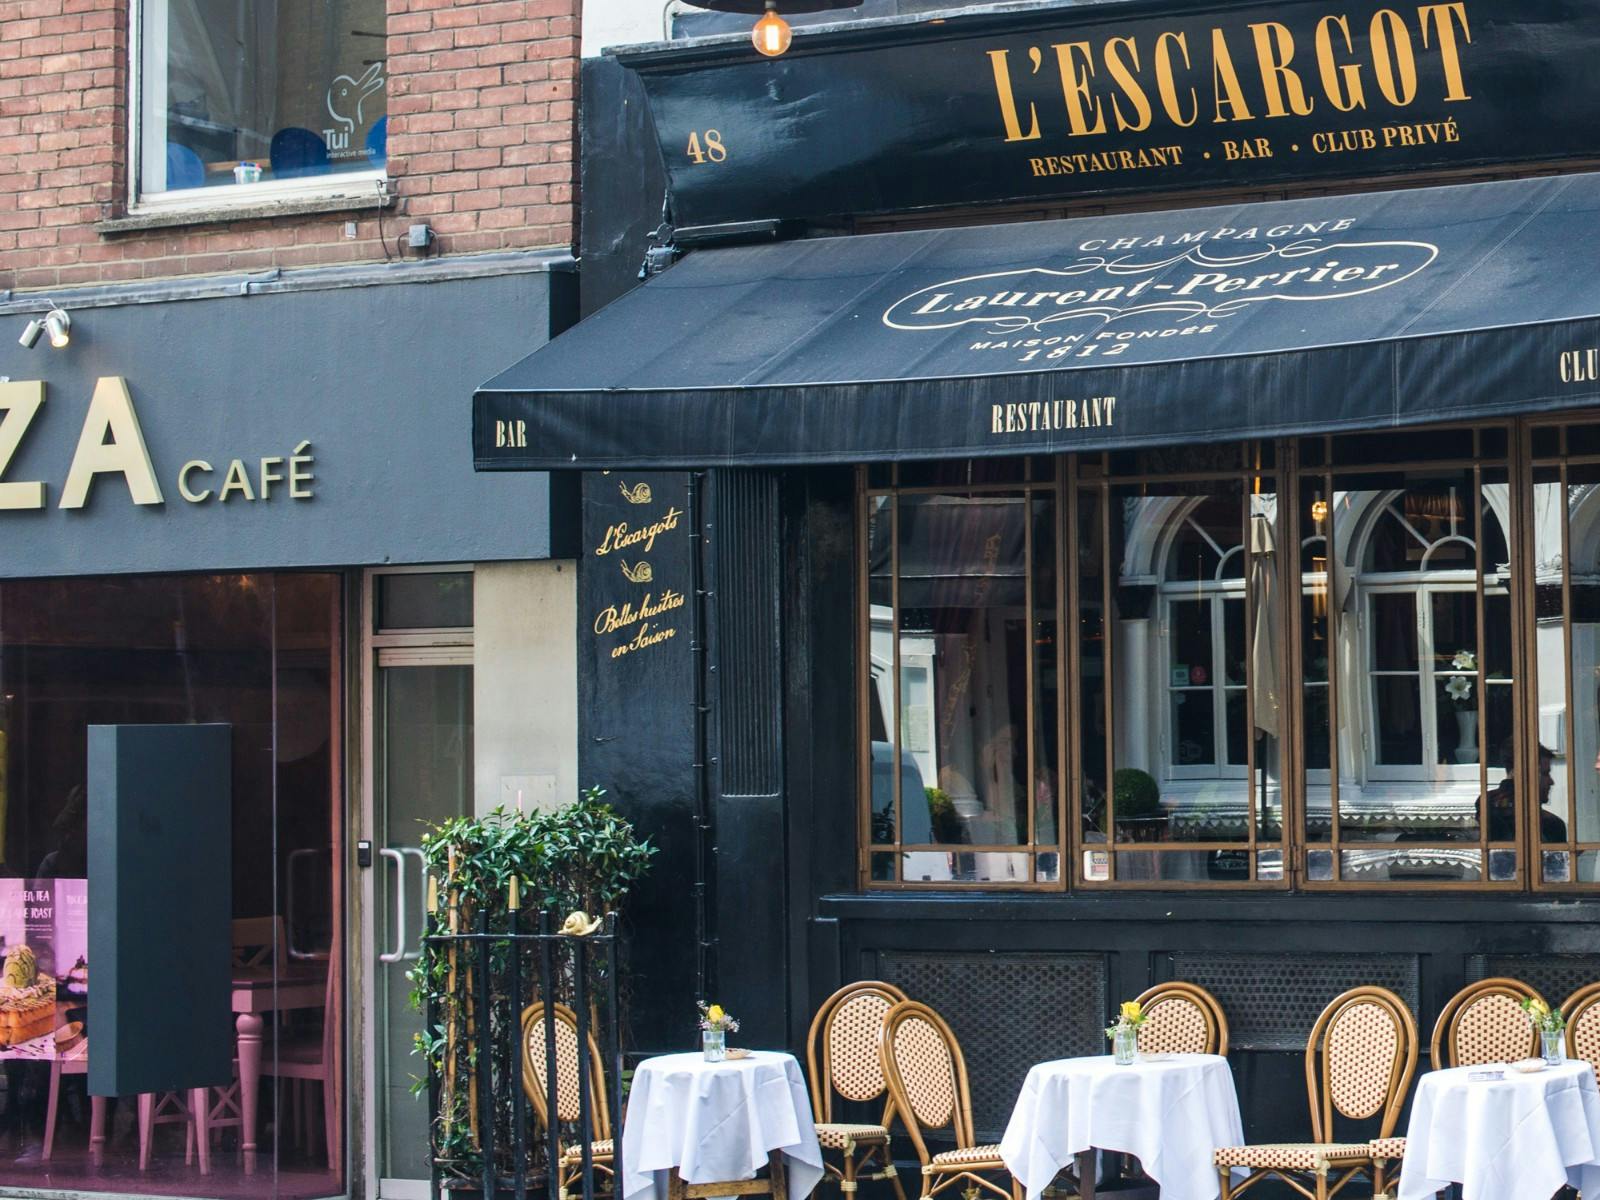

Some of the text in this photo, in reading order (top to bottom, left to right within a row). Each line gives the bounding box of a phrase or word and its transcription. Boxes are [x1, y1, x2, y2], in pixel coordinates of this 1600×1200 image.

[986, 2, 1471, 142] L'ESCARGOT
[322, 126, 348, 150] Tui
[686, 128, 728, 164] 48
[1030, 117, 1460, 177] RESTAURANT BAR CLUB PRIVÉ
[1078, 216, 1359, 253] CHAMPAGNE
[910, 260, 1400, 315] Laurent-Perrier
[969, 323, 1220, 351] MAISON FONDÉE
[1018, 343, 1131, 362] 1812
[991, 396, 1116, 434] RESTAURANT
[495, 420, 527, 448] BAR
[178, 440, 315, 503] CAFÉ
[595, 507, 684, 556] L'Escargots
[594, 604, 639, 635] Belles
[611, 645, 629, 658] en
[36, 890, 50, 902] TEA
